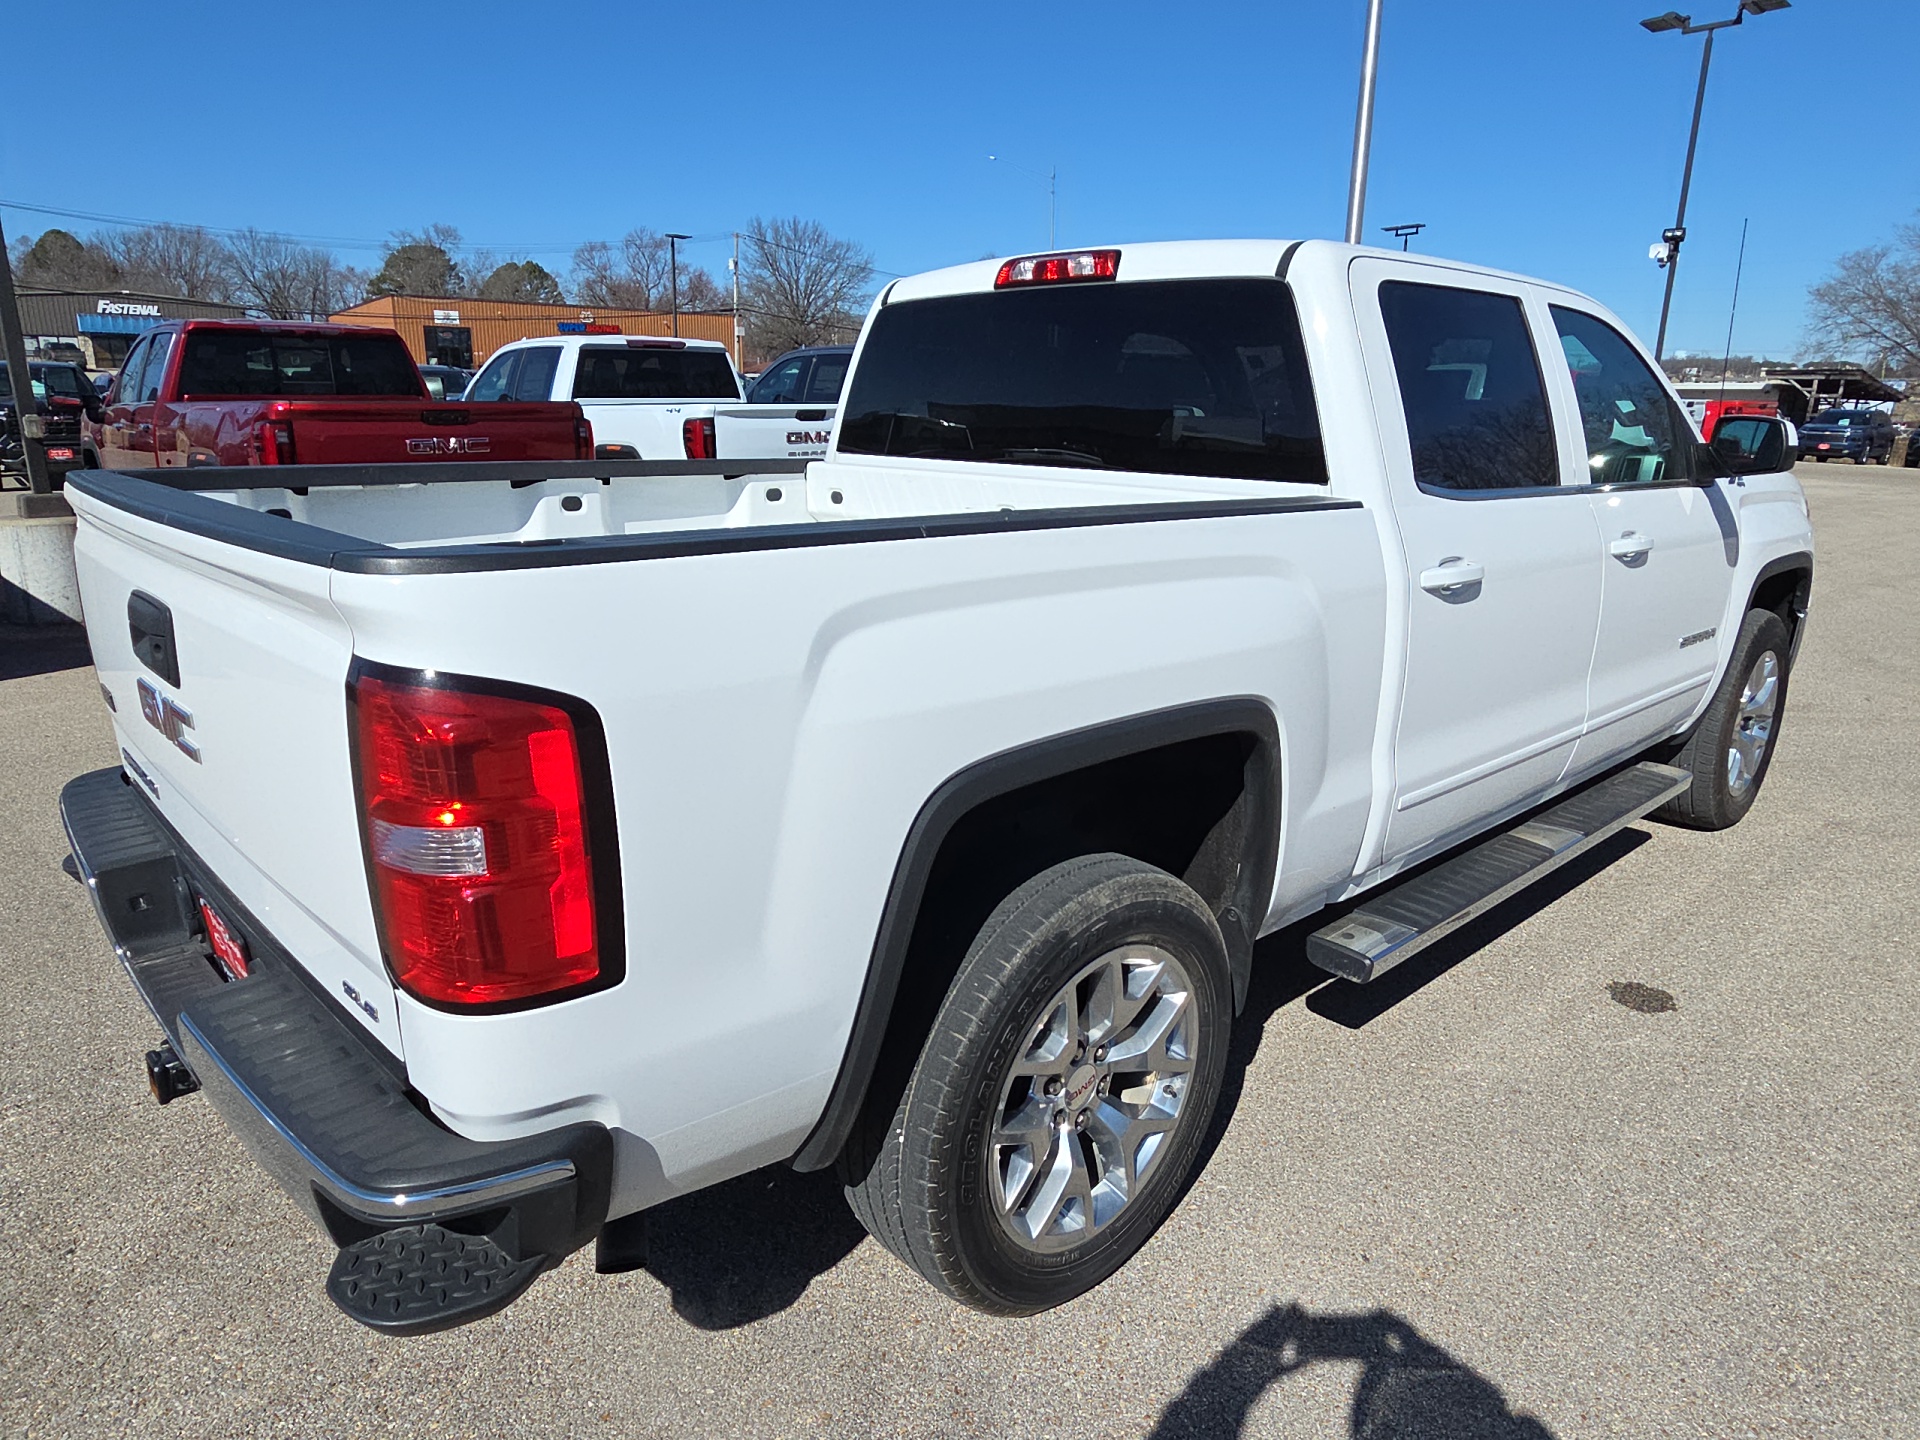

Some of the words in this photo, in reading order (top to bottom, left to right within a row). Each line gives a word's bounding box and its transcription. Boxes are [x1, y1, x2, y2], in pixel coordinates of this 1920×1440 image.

[97, 299, 161, 316] FASTENAL
[557, 322, 585, 333] SUPER
[405, 437, 491, 454] GMC
[136, 677, 203, 765] GMC
[342, 980, 379, 1023] SLE
